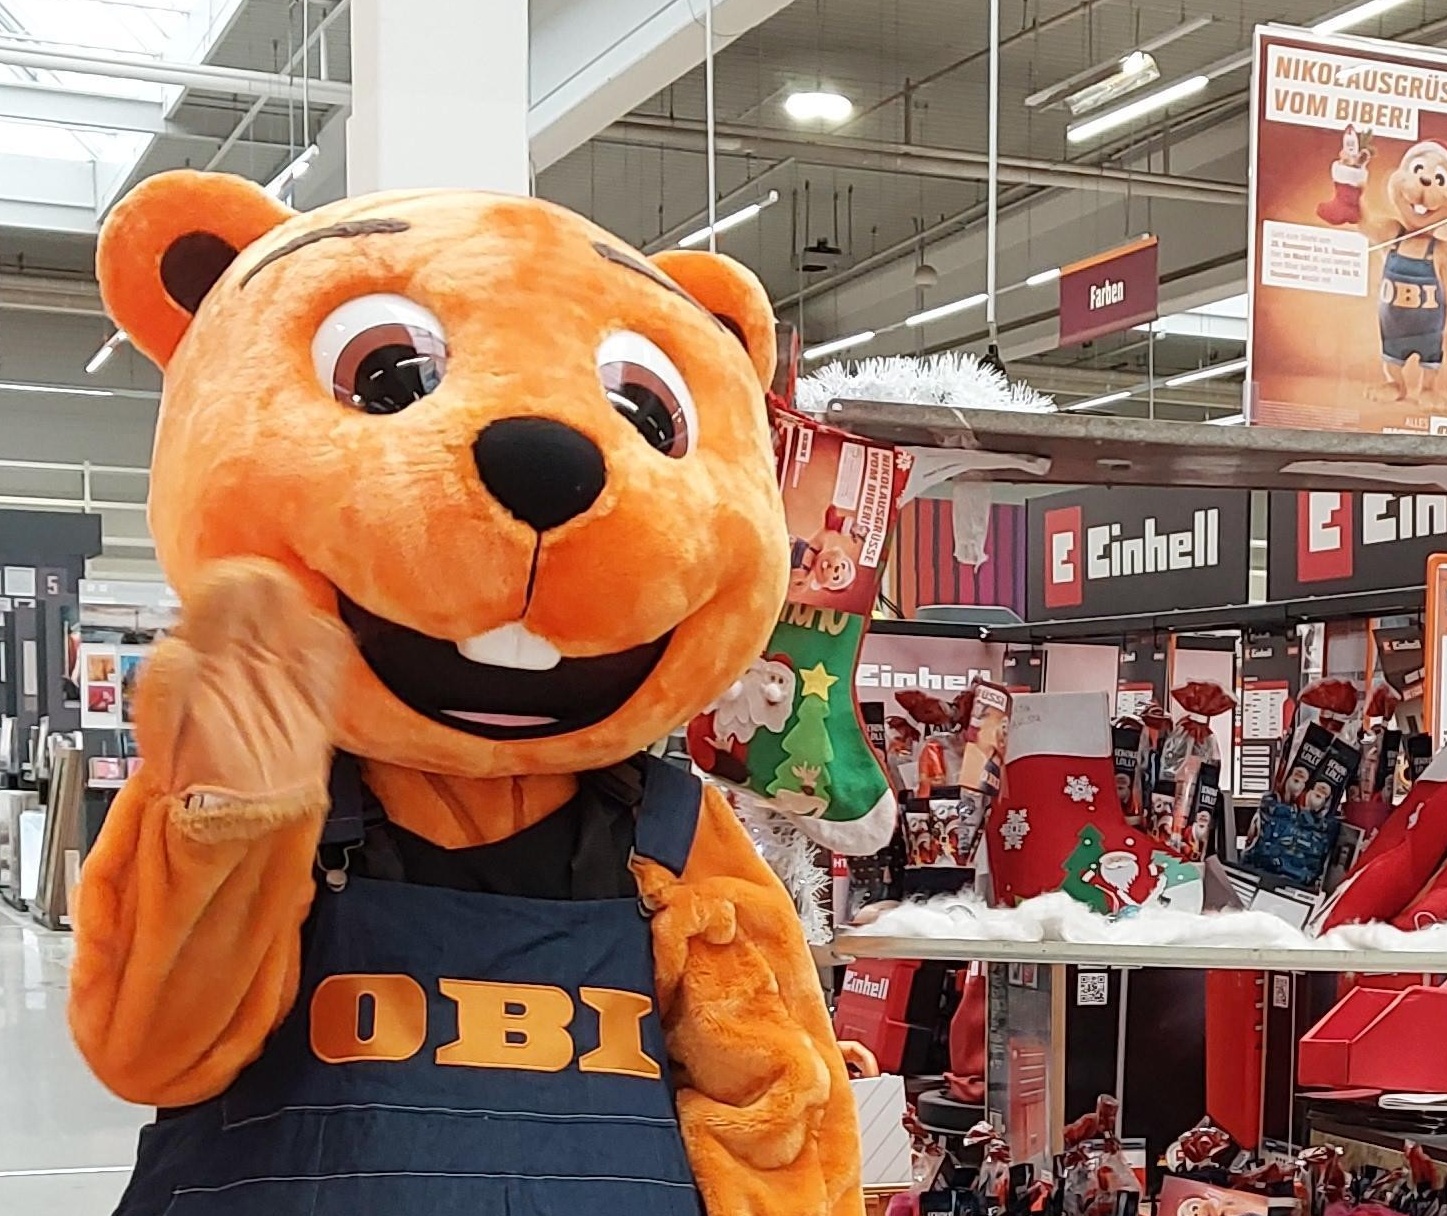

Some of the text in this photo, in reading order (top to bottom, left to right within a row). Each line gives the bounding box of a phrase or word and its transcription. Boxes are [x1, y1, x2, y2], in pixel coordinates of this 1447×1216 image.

[1274, 88, 1412, 130] VOM BIBER!
[1089, 279, 1125, 311] Farben
[1380, 281, 1440, 310] OBI
[868, 451, 880, 481] VOM
[1087, 508, 1220, 580] Einhell
[842, 970, 890, 1000] Einhell
[309, 973, 661, 1080] OBI
